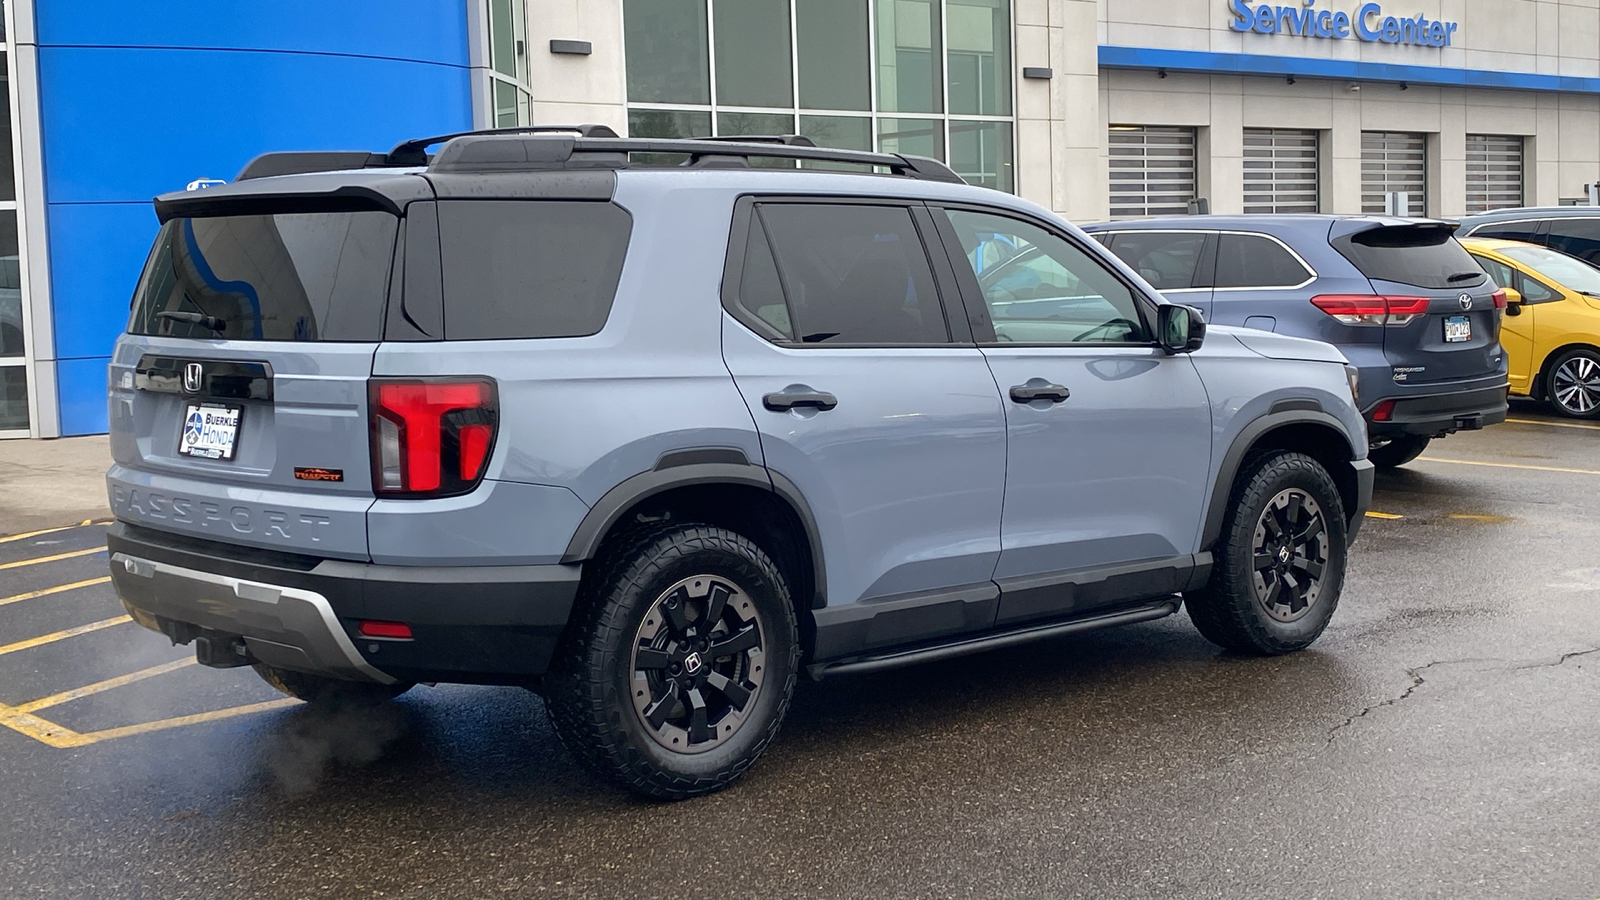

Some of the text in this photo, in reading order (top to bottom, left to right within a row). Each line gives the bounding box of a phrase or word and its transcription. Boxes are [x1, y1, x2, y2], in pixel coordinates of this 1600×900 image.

[1229, 0, 1458, 47] Service Center
[201, 425, 234, 446] HONDA
[205, 413, 239, 427] BUERKLE
[111, 483, 330, 541] PASSPORT
